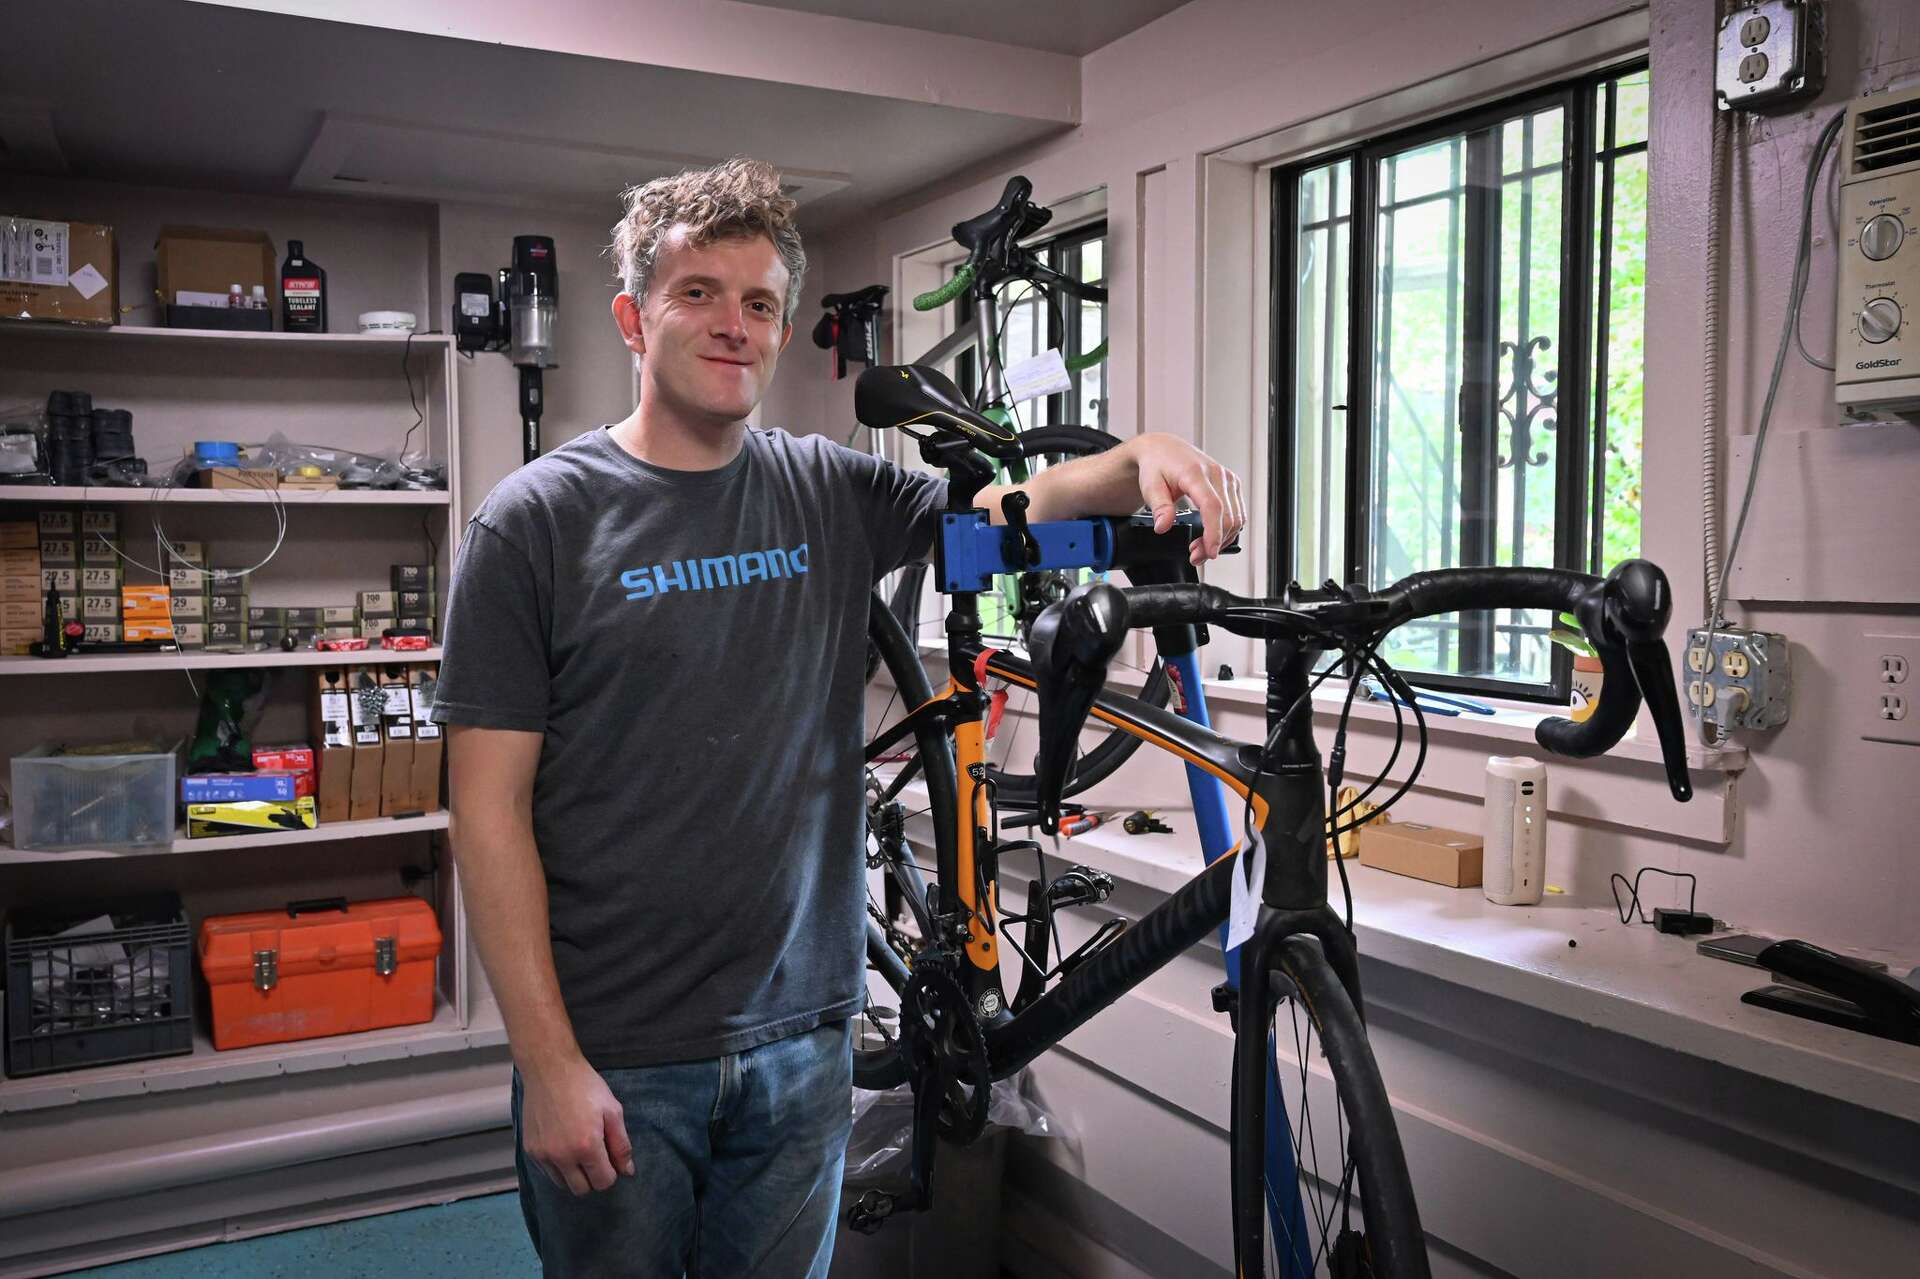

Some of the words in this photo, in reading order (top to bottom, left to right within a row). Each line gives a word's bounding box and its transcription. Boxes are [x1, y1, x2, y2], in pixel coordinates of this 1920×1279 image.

[1856, 358, 1902, 370] GoldStar
[44, 542, 70, 552] 27.5
[87, 571, 110, 581] 27.5
[174, 571, 186, 580] 29
[403, 567, 418, 576] 700
[366, 594, 380, 602] 700
[404, 593, 419, 601] 700
[87, 599, 111, 609] 27.5
[174, 598, 187, 607] 29
[213, 597, 227, 607] 29
[402, 618, 416, 626] 700
[86, 627, 110, 637] 27.5
[174, 625, 187, 634] 29
[213, 624, 226, 633] 29
[972, 766, 985, 777] 52
